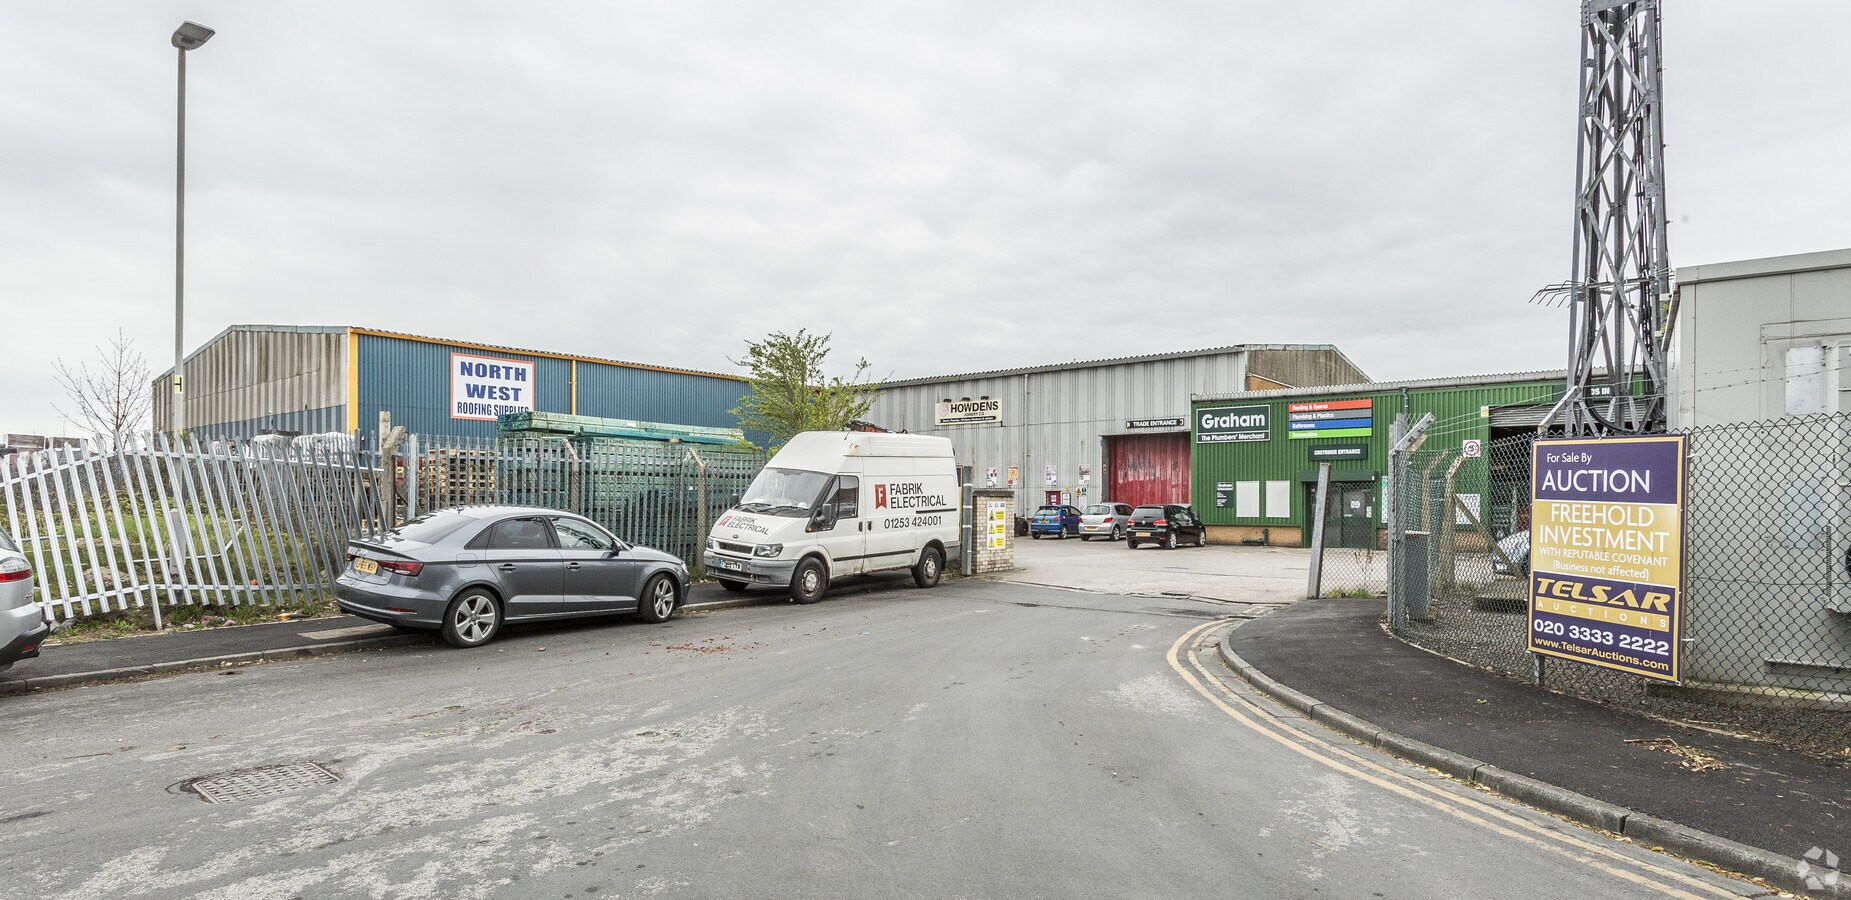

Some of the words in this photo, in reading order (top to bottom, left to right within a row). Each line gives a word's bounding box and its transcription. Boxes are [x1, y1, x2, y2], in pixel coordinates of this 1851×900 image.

[460, 361, 527, 382] NORTH
[465, 383, 522, 401] WEST
[457, 401, 492, 416] ROOFING
[951, 401, 998, 413] HOWDENS
[1201, 413, 1266, 429] Graham
[1546, 453, 1560, 463] For
[1562, 452, 1579, 463] Sale
[1581, 453, 1592, 465] By
[889, 483, 923, 495] FABRIK
[1541, 469, 1650, 493] AUCTION
[878, 487, 883, 504] F
[890, 494, 946, 509] ELECTRICAL
[732, 515, 757, 524] FABRIK
[884, 517, 910, 529] 01253
[911, 515, 942, 527] 424001
[1551, 503, 1654, 527] FREEHOLD
[727, 521, 769, 535] ELECTRICAL
[1540, 524, 1669, 553] INVESTMENT
[1539, 546, 1560, 557] WITH
[1563, 548, 1609, 562] REPUTABLE
[1612, 552, 1668, 567] COVENANT
[1553, 560, 1588, 573] (Business
[1590, 566, 1605, 575] not
[1607, 565, 1649, 581] affected)
[1537, 577, 1671, 612] TELSAR
[1537, 600, 1666, 628] AUCTIONS
[1534, 619, 1564, 636] 020
[1568, 625, 1614, 645] 3333
[1619, 634, 1669, 656] 2222
[1534, 636, 1669, 671] www.TelsarAuctions.com
